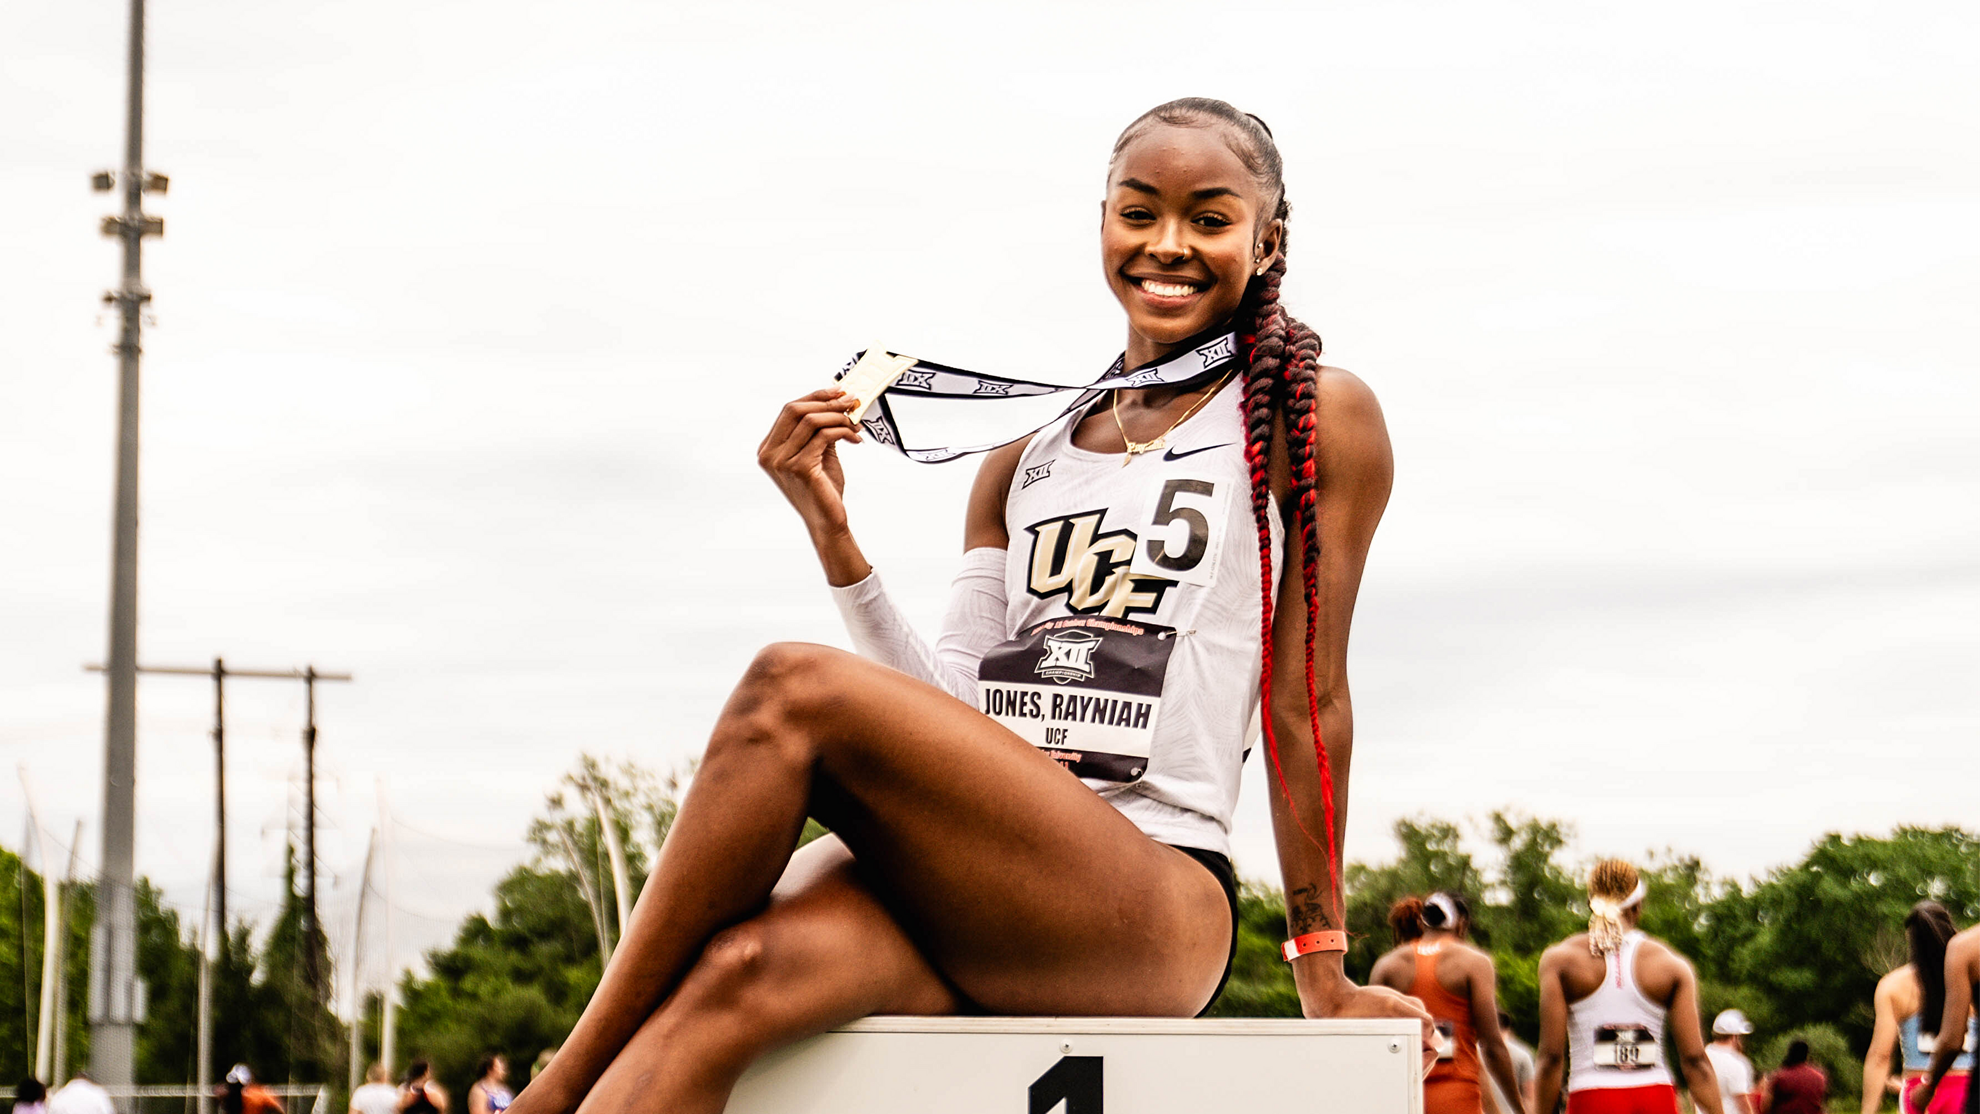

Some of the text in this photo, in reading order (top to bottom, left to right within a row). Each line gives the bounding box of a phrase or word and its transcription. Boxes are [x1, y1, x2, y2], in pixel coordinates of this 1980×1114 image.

[1146, 478, 1215, 572] 5
[1024, 507, 1180, 620] UCF
[1038, 637, 1099, 673] XII
[985, 688, 1153, 730] JONES, RAYNIAH
[1045, 727, 1069, 746] UCF
